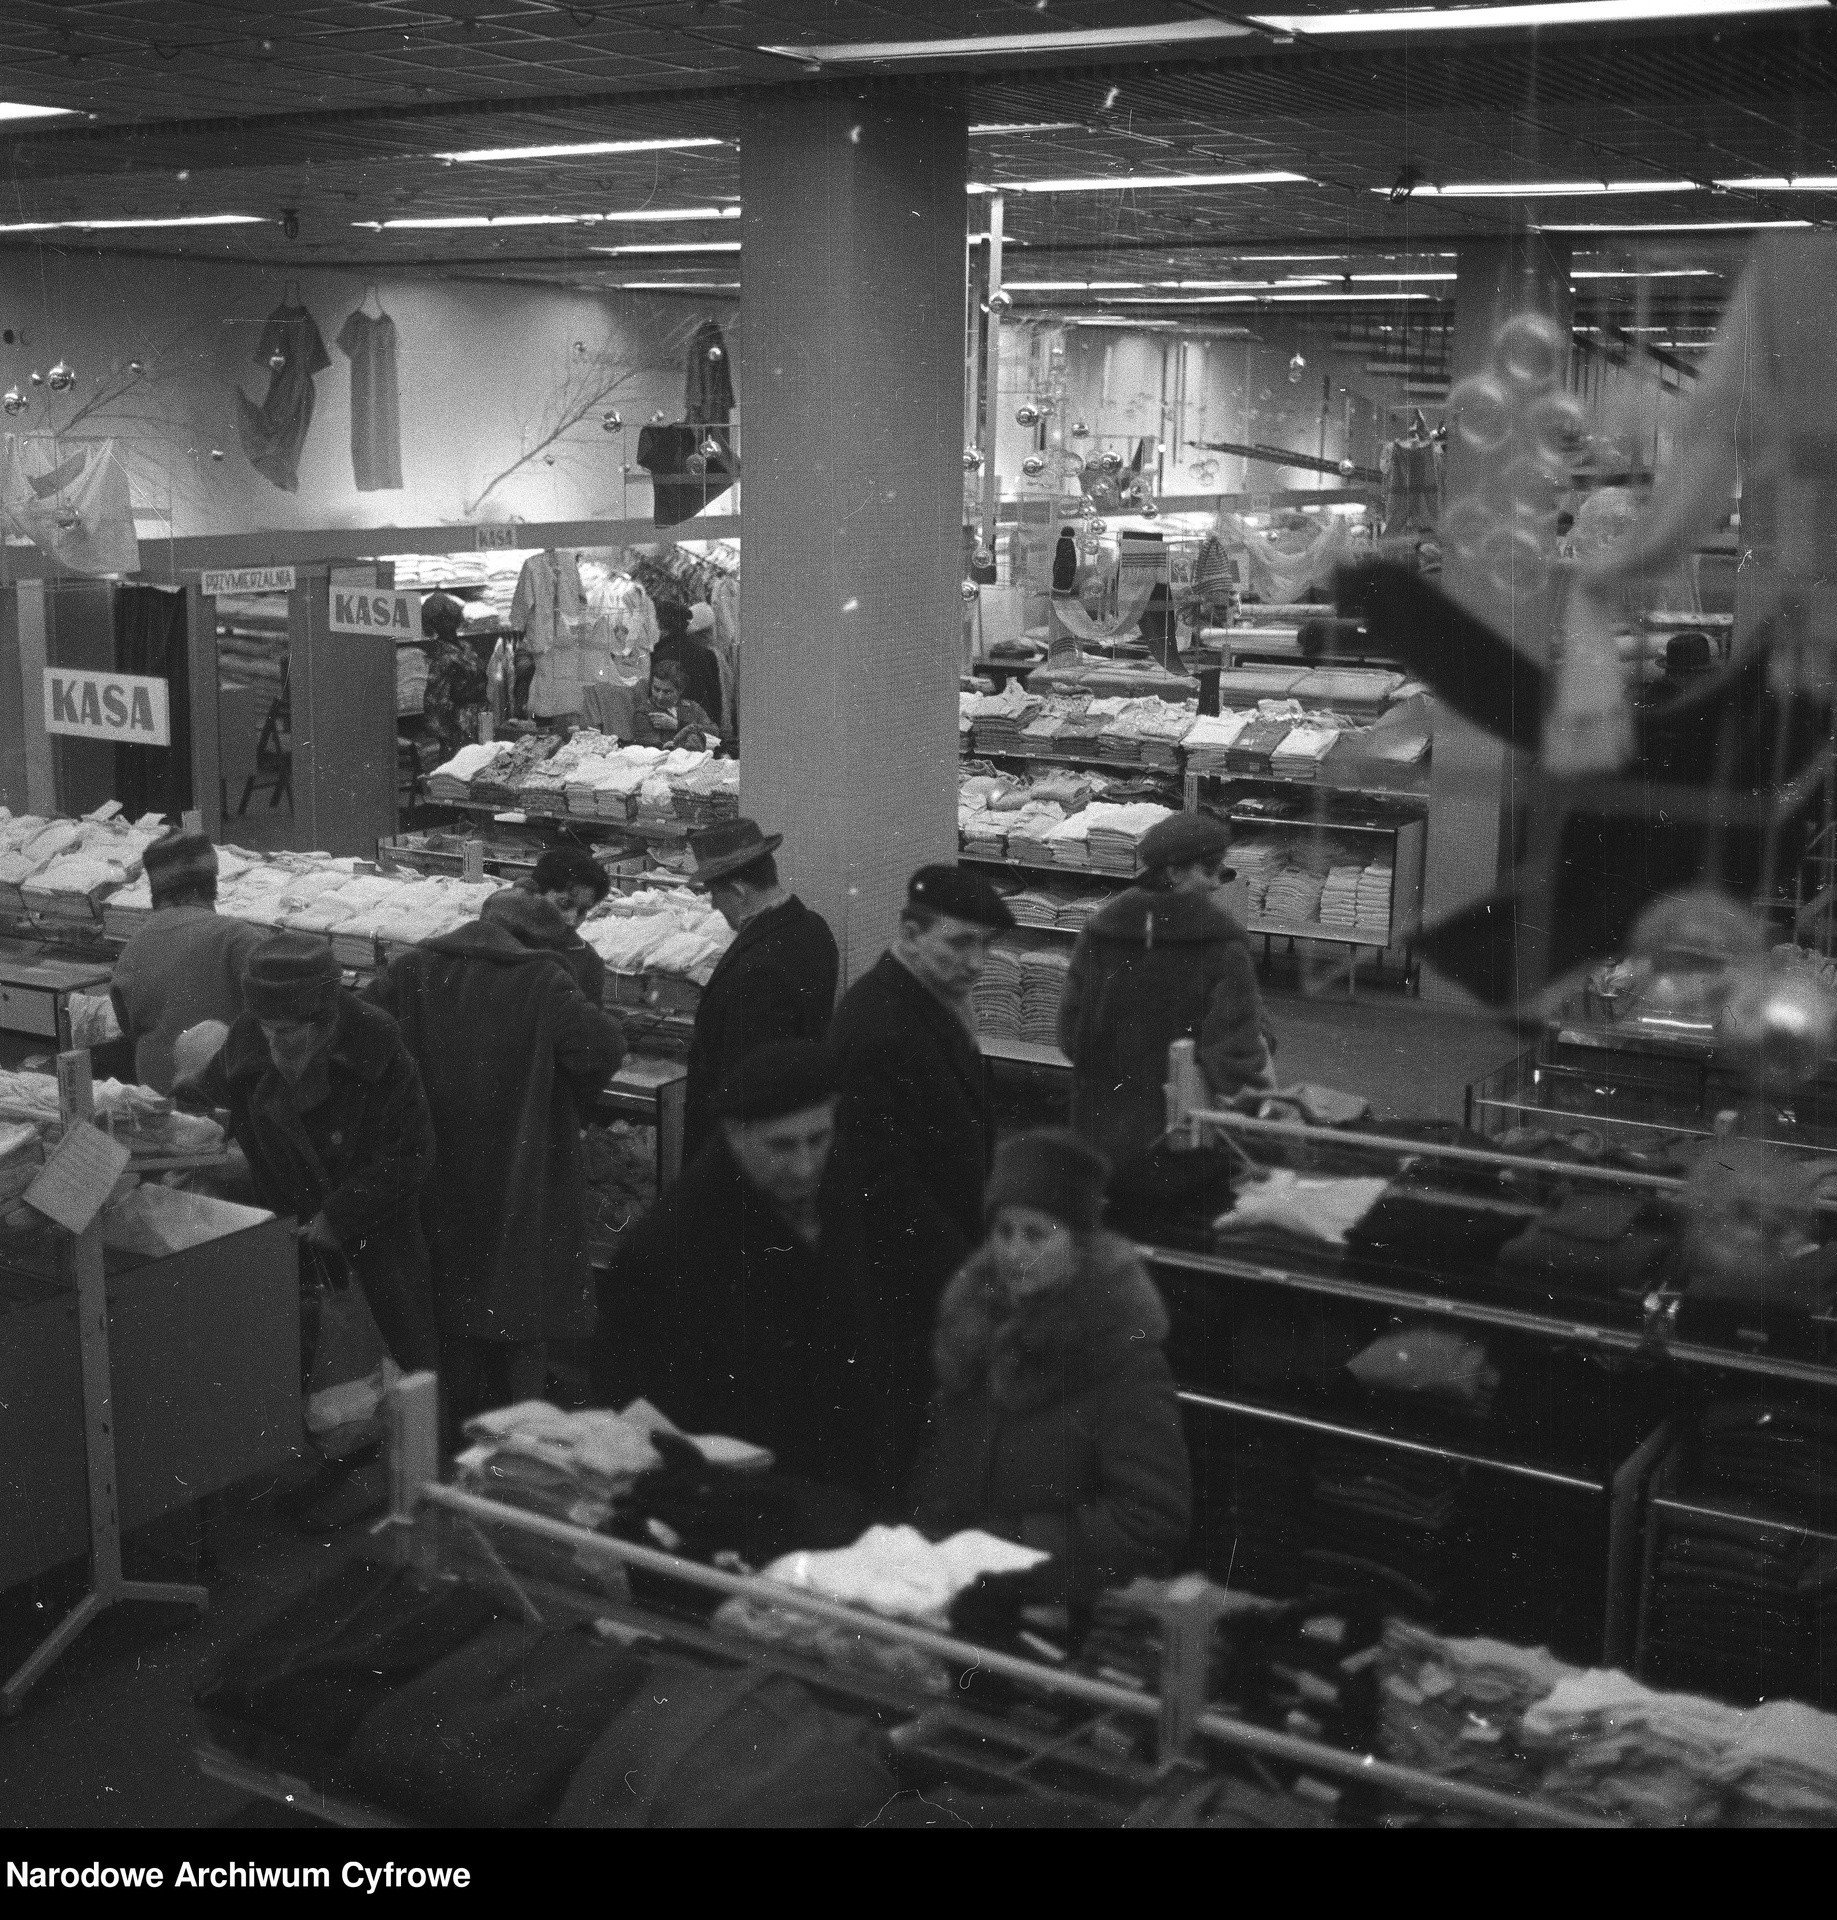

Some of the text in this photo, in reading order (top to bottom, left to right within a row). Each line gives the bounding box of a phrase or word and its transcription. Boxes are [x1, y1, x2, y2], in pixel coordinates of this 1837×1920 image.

[479, 529, 512, 547] KASA
[335, 593, 411, 629] KASA
[52, 679, 155, 732] KASA
